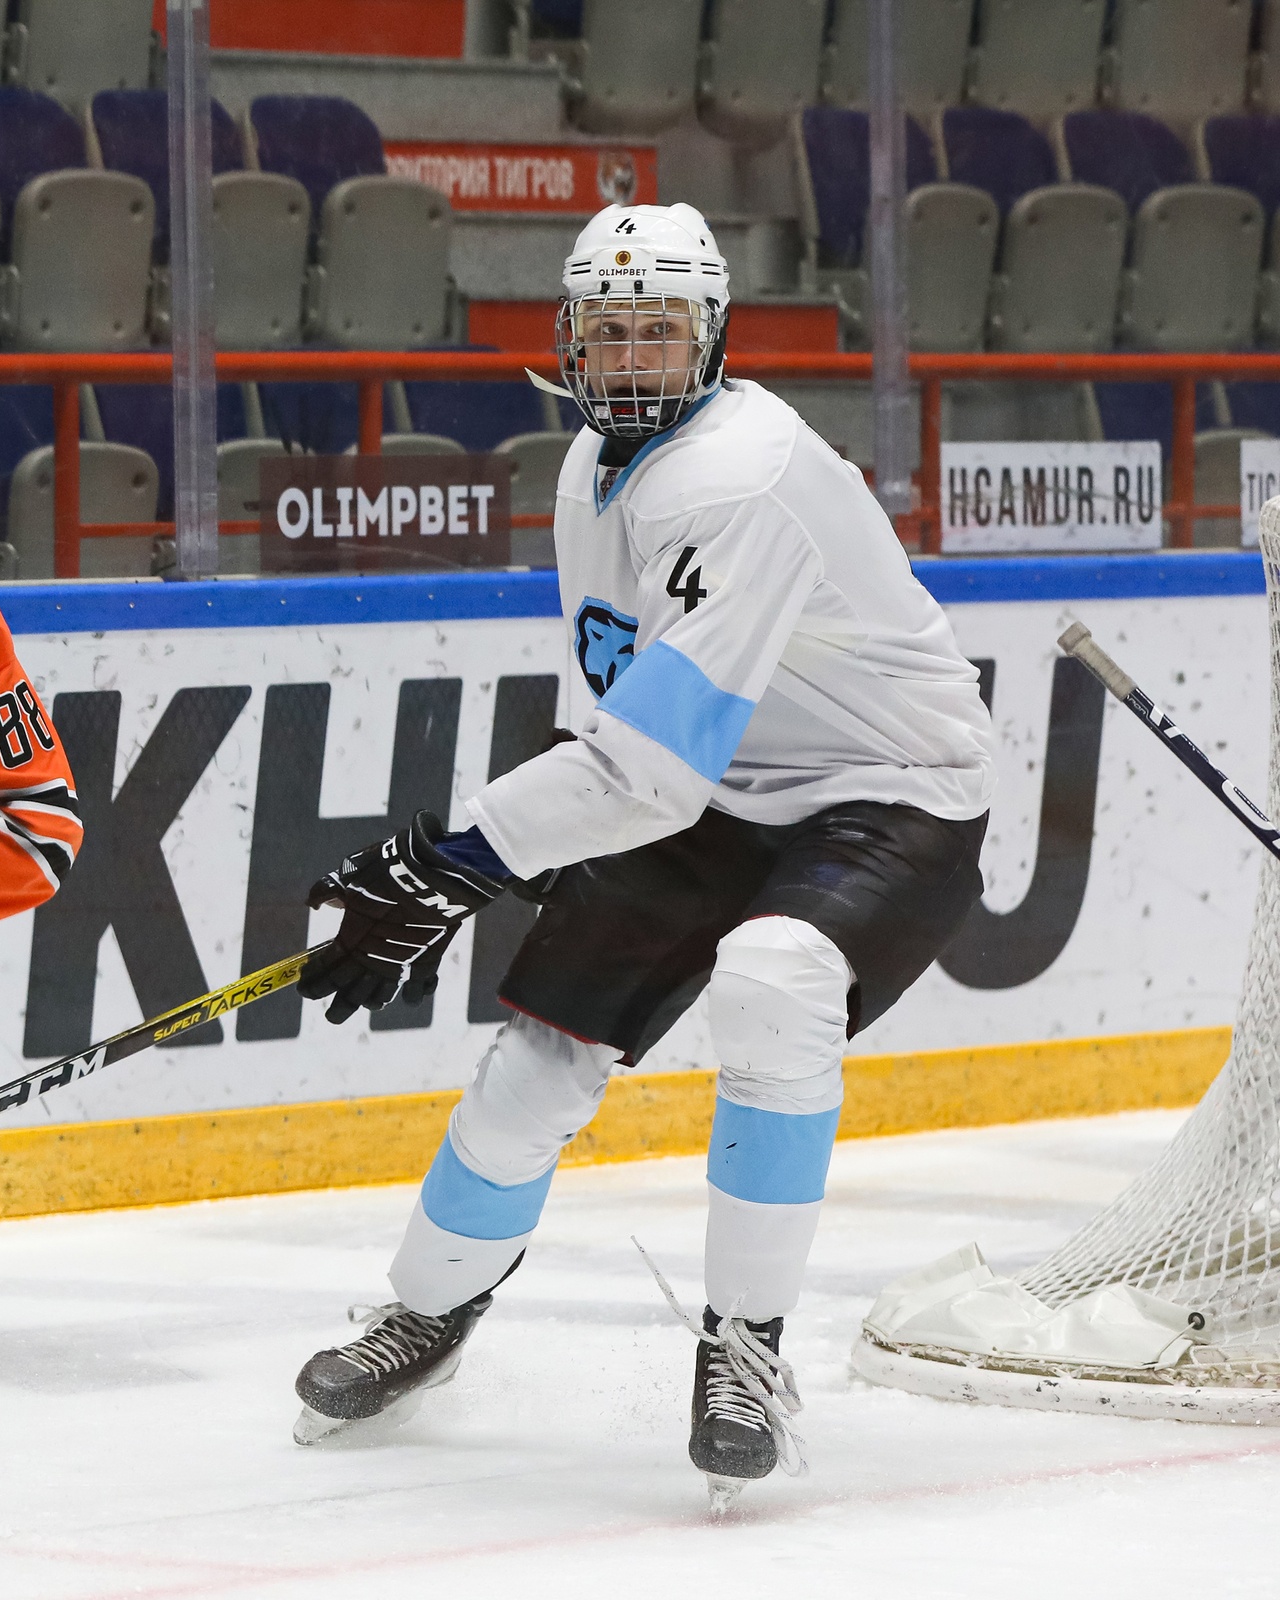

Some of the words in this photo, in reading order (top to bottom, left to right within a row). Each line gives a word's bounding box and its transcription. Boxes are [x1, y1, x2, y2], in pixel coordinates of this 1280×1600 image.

[615, 217, 637, 235] 4
[598, 268, 647, 277] OLIMPBET
[276, 484, 495, 539] OLIMPBET
[949, 465, 1155, 527] HCAMUR.RU
[1247, 472, 1280, 513] TIC
[665, 545, 708, 615] 4
[381, 834, 470, 919] CCM
[153, 1012, 202, 1042] SUPER
[201, 976, 274, 1023] TACKS
